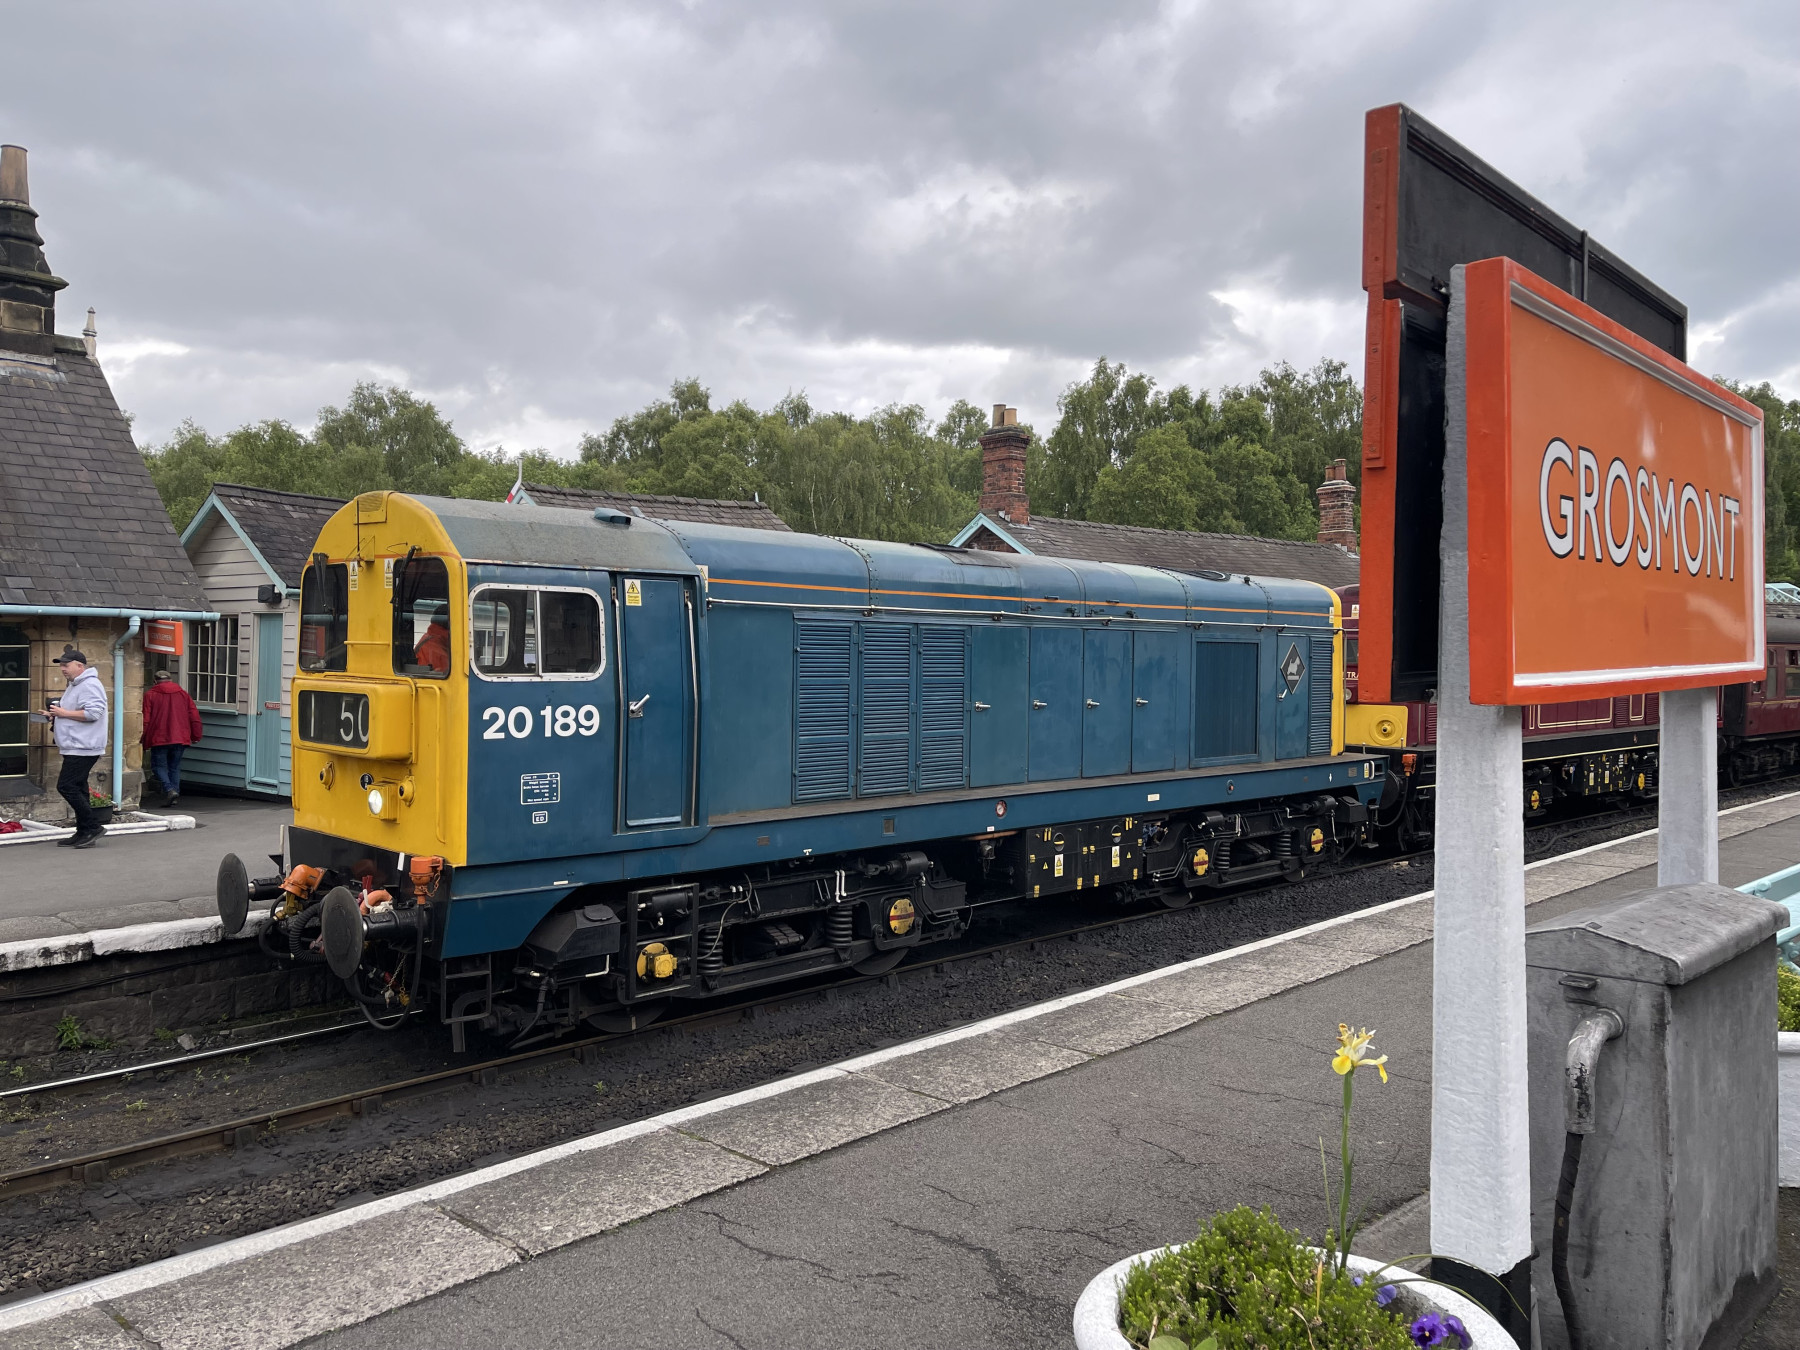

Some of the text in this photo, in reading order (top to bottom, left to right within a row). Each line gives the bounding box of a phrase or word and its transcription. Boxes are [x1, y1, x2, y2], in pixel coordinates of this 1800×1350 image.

[1539, 437, 1739, 582] GROSMONT
[482, 704, 600, 740] 20 189
